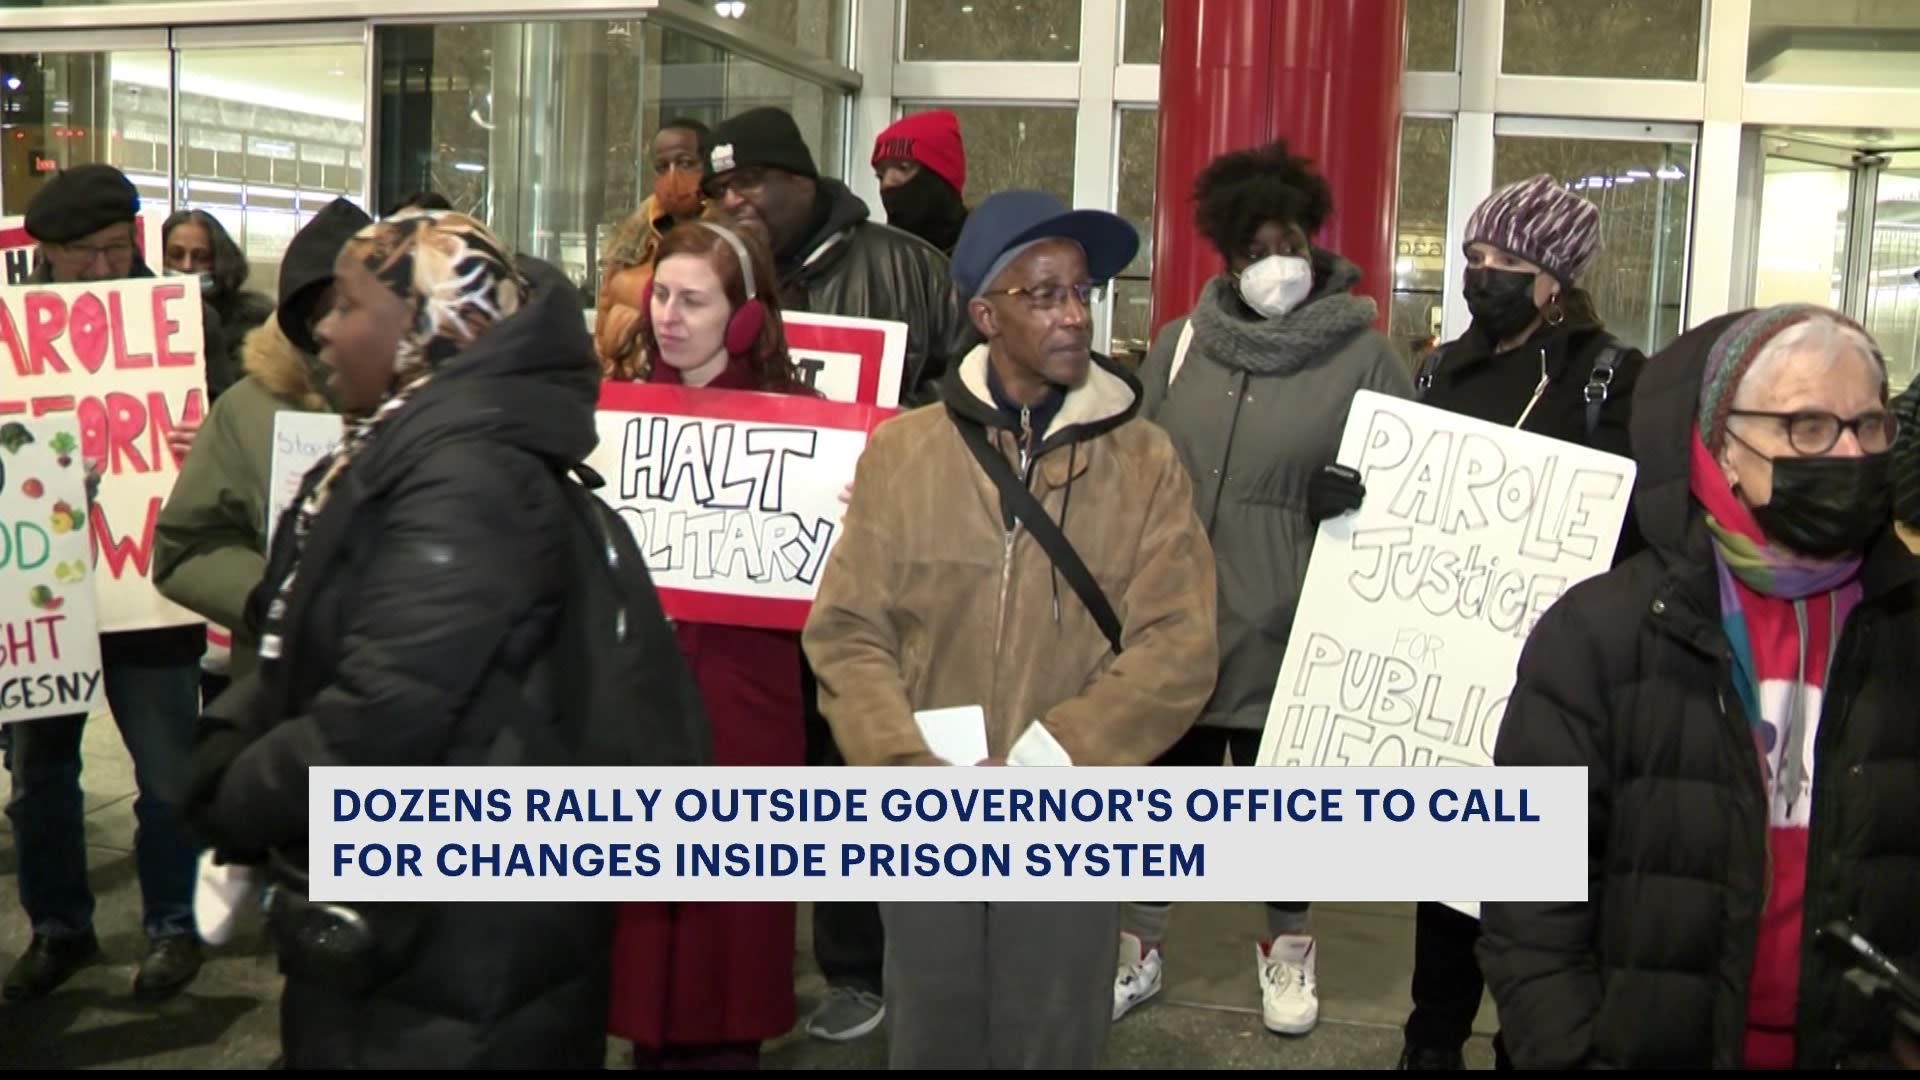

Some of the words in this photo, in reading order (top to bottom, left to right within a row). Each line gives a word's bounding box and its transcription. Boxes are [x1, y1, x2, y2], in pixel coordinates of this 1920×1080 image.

[620, 417, 817, 512] HALT
[1358, 409, 1625, 562] PAROLE
[1392, 628, 1445, 670] FOR
